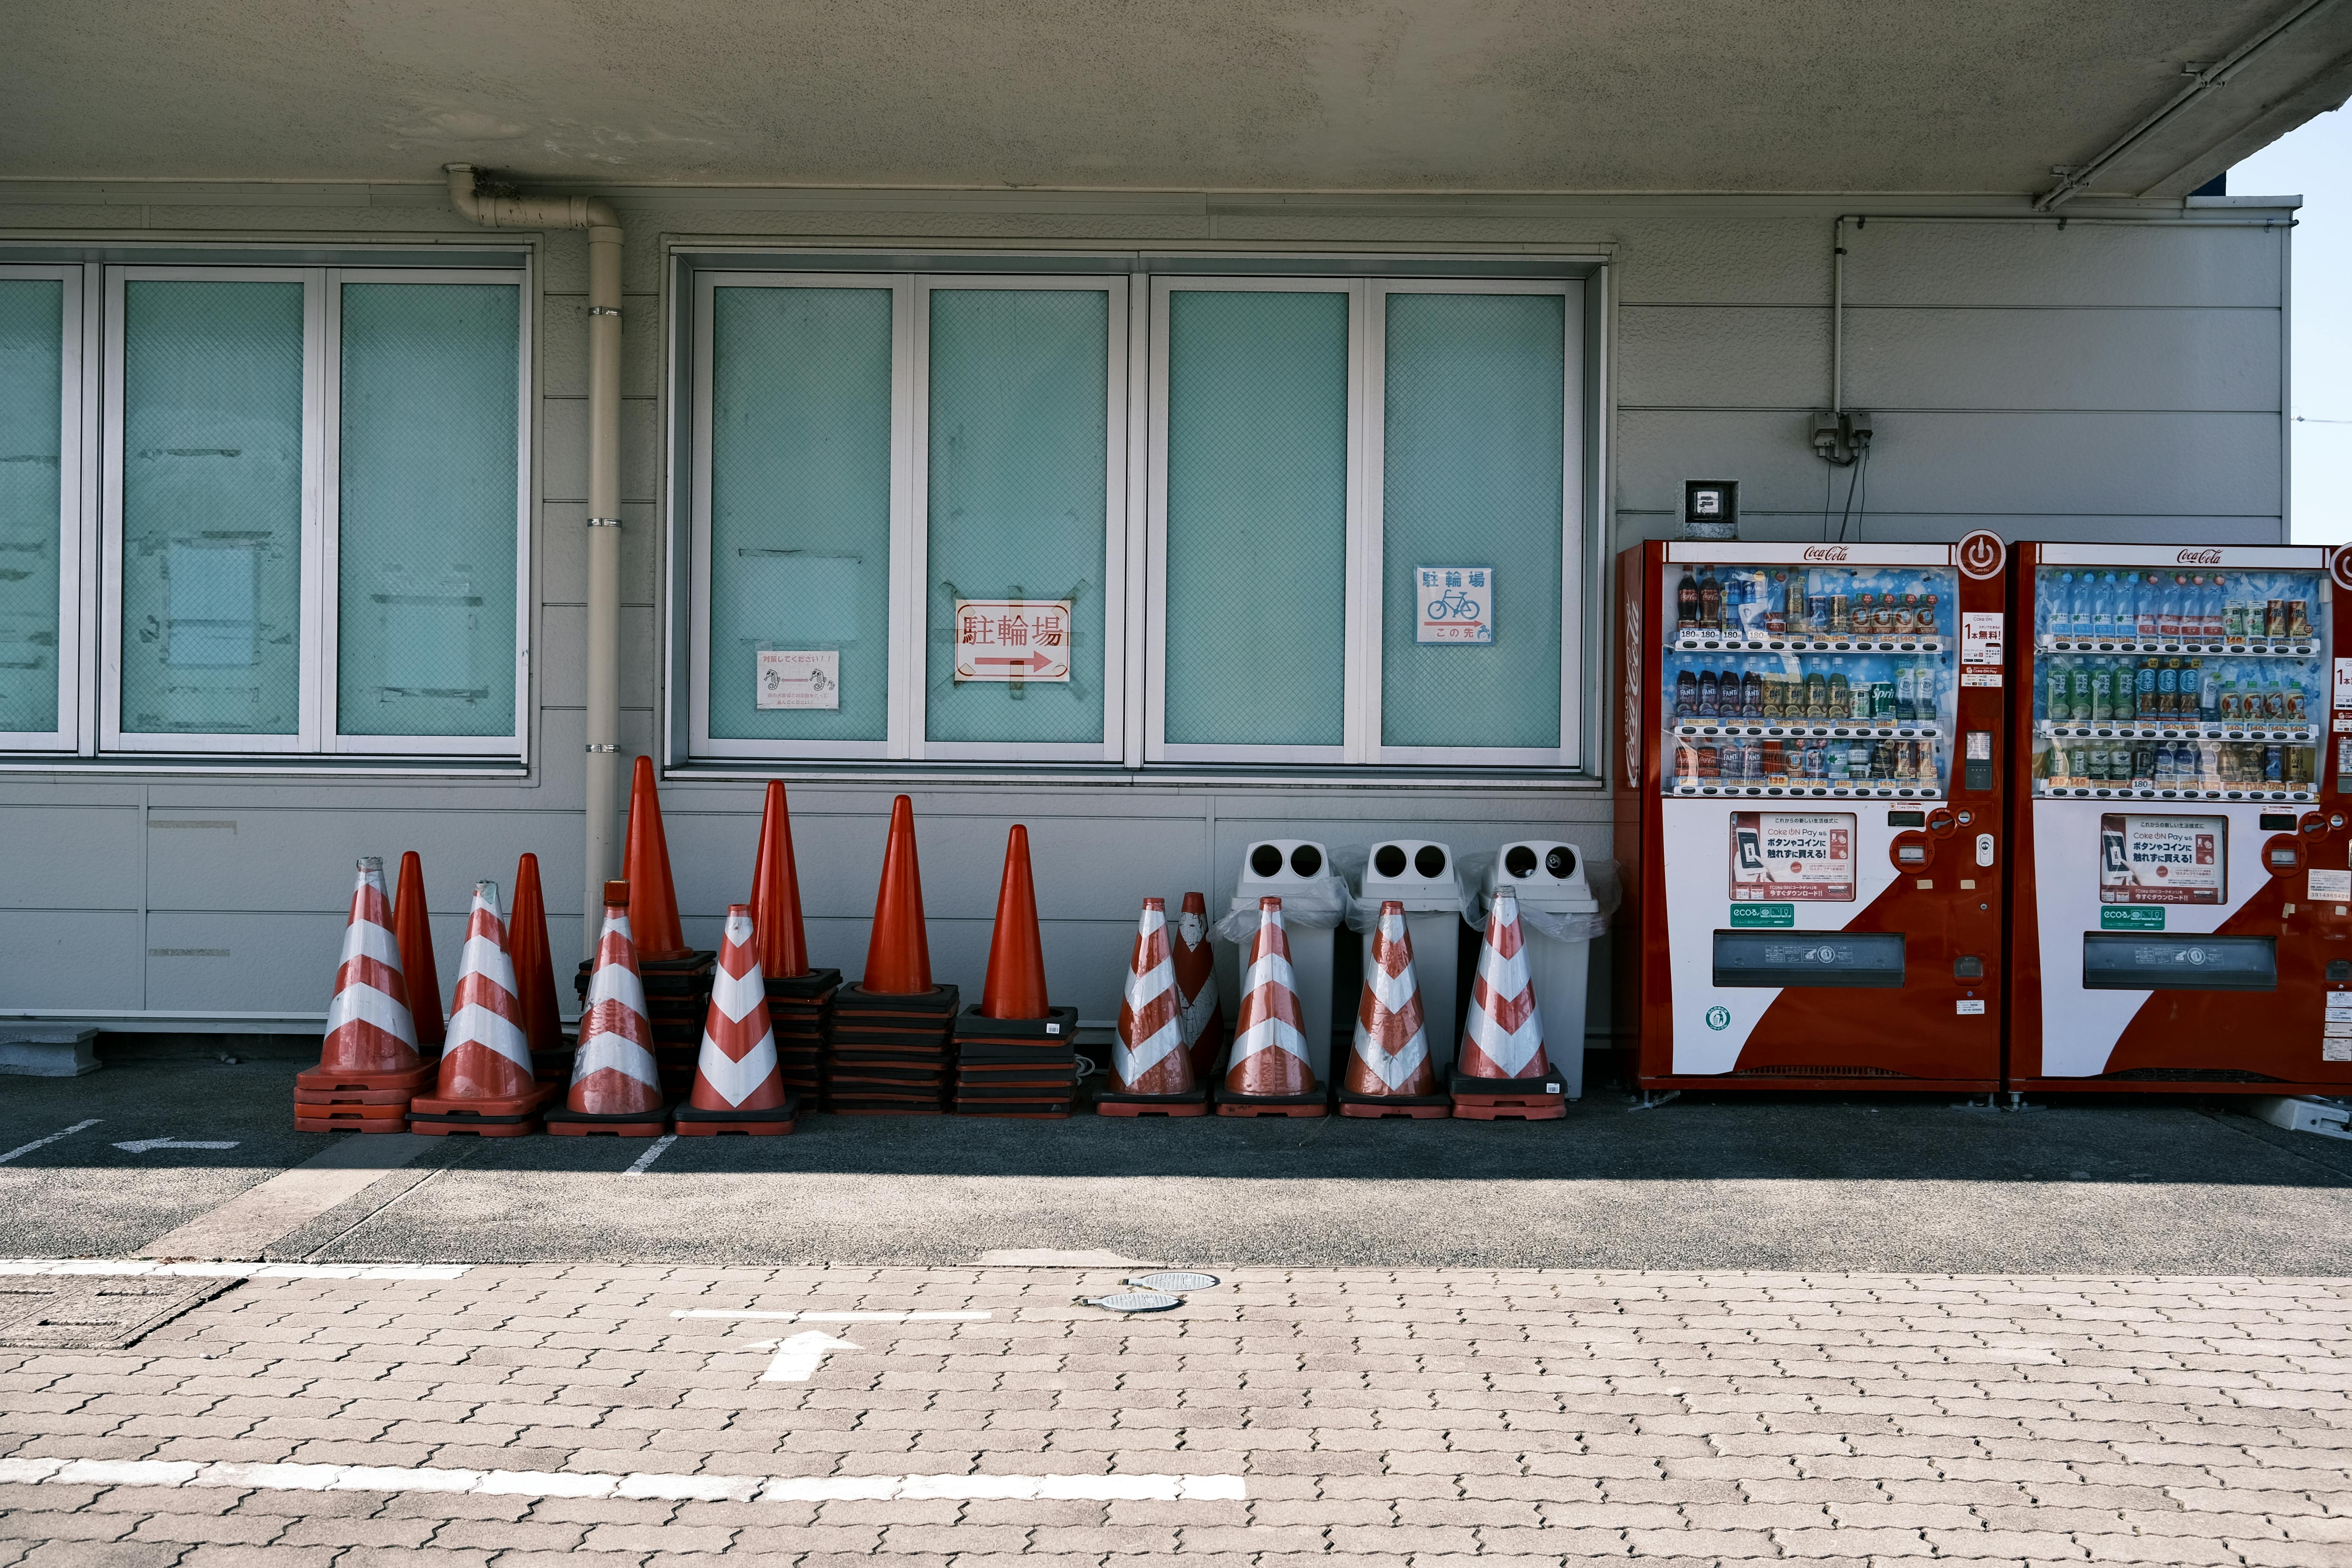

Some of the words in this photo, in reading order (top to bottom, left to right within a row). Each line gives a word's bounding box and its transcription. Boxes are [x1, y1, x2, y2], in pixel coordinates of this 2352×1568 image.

[1804, 546, 1850, 560] Coca-Cola
[2177, 549, 2223, 564] Coca-Cola
[1423, 571, 1485, 587] 駐輪場
[962, 615, 1063, 646] 駐輪場
[1437, 628, 1473, 638] この先
[2144, 672, 2152, 689] 麦茶
[2165, 672, 2173, 689] 麦茶
[2187, 672, 2195, 689] 麦茶
[1802, 829, 1817, 837] Pay
[2133, 842, 2192, 851] ボタンやコインに
